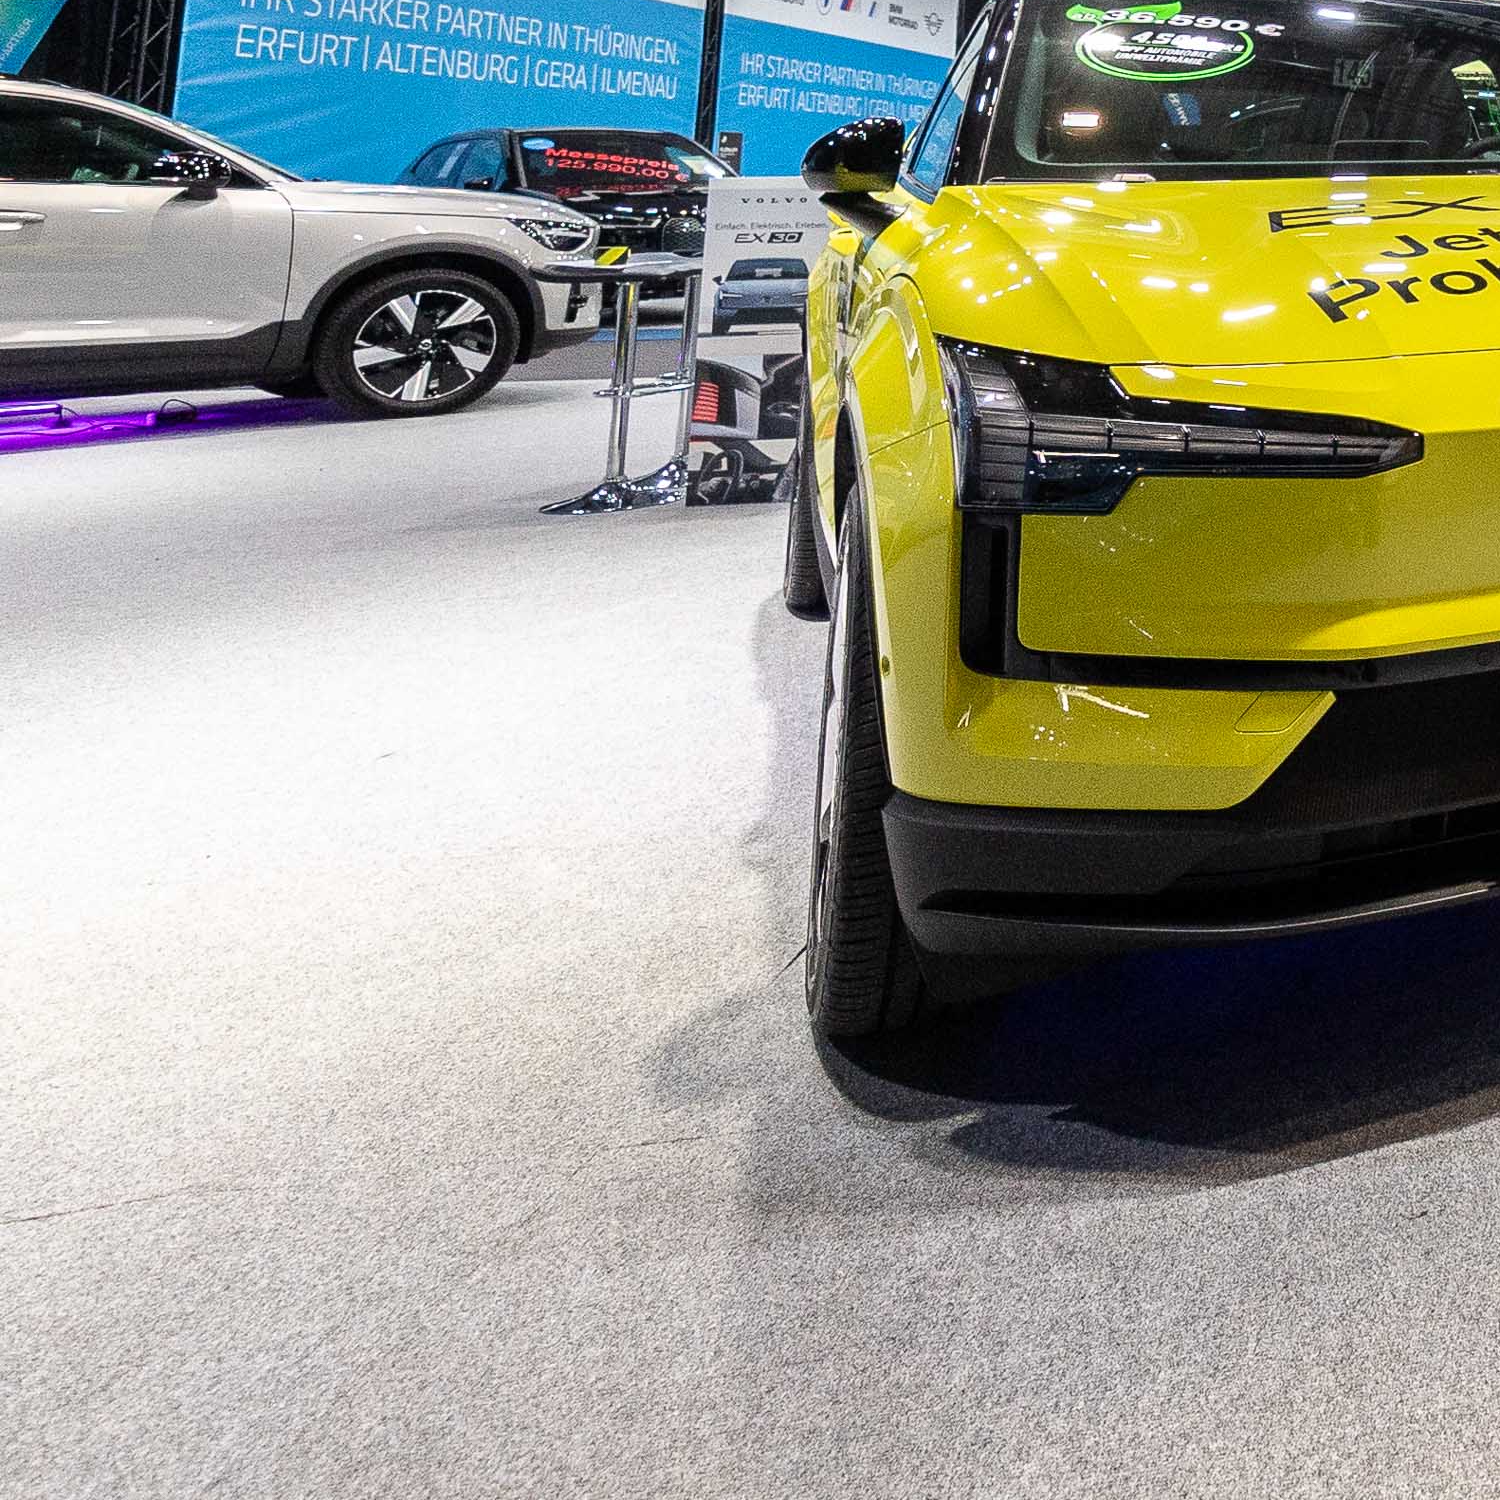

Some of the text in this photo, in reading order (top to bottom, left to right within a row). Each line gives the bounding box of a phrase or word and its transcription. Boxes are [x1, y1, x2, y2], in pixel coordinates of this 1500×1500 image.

[436, 3, 542, 47] PARTNER
[549, 23, 567, 50] IN
[572, 24, 680, 65] THÜRINGEN.
[1101, 9, 1250, 32] 36.590
[1255, 23, 1285, 36] €
[235, 24, 678, 100] ERFURT ALTENBURG GERA ILMENAU
[740, 52, 765, 76] IHR
[766, 55, 821, 83] STARKER
[823, 64, 875, 91] PARTNER
[875, 74, 886, 93] IN
[738, 84, 791, 109] ERFURT
[799, 91, 862, 117] ALTENBURG
[545, 148, 680, 171] Messepreis
[715, 222, 747, 230] Einfach.
[795, 221, 828, 229] Erleben.
